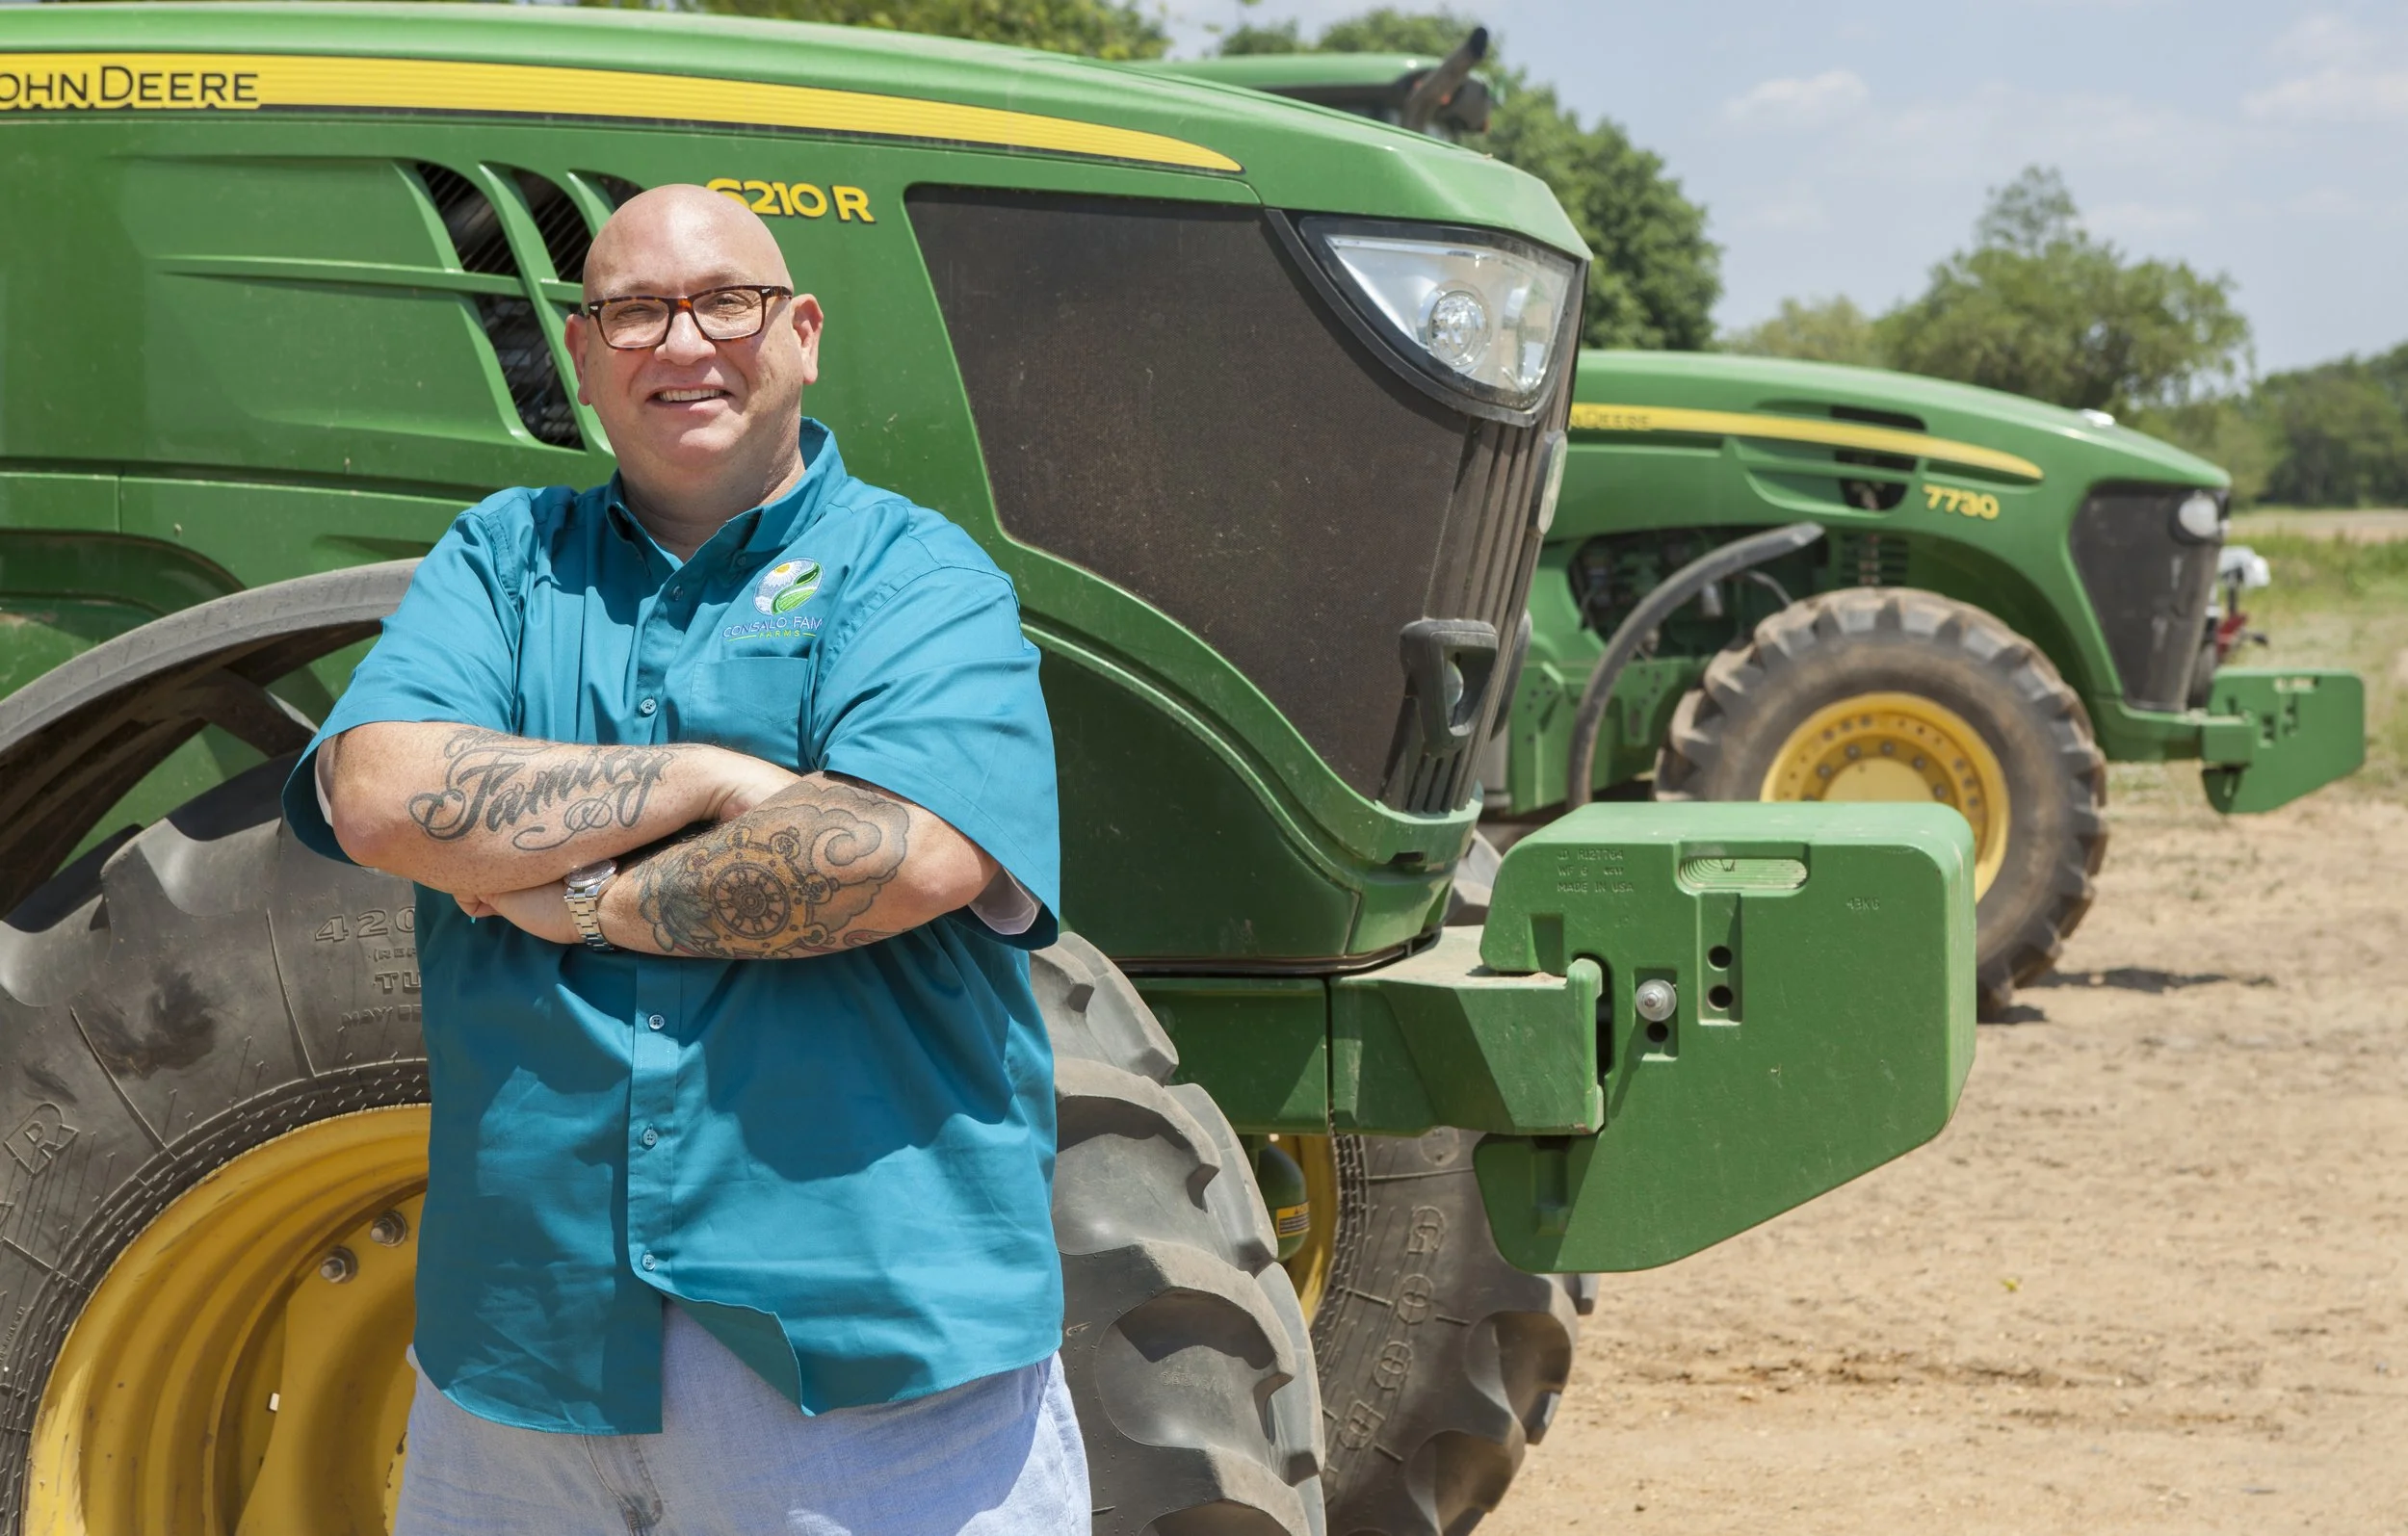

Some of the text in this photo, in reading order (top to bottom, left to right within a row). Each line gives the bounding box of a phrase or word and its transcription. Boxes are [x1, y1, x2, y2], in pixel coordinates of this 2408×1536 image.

[100, 65, 258, 102] DEERE
[831, 184, 876, 223] R
[1922, 483, 2000, 520] 7730
[722, 616, 788, 638] CONSALO
[758, 629, 800, 638] FARMS
[1557, 880, 1635, 893] MADE IN USA
